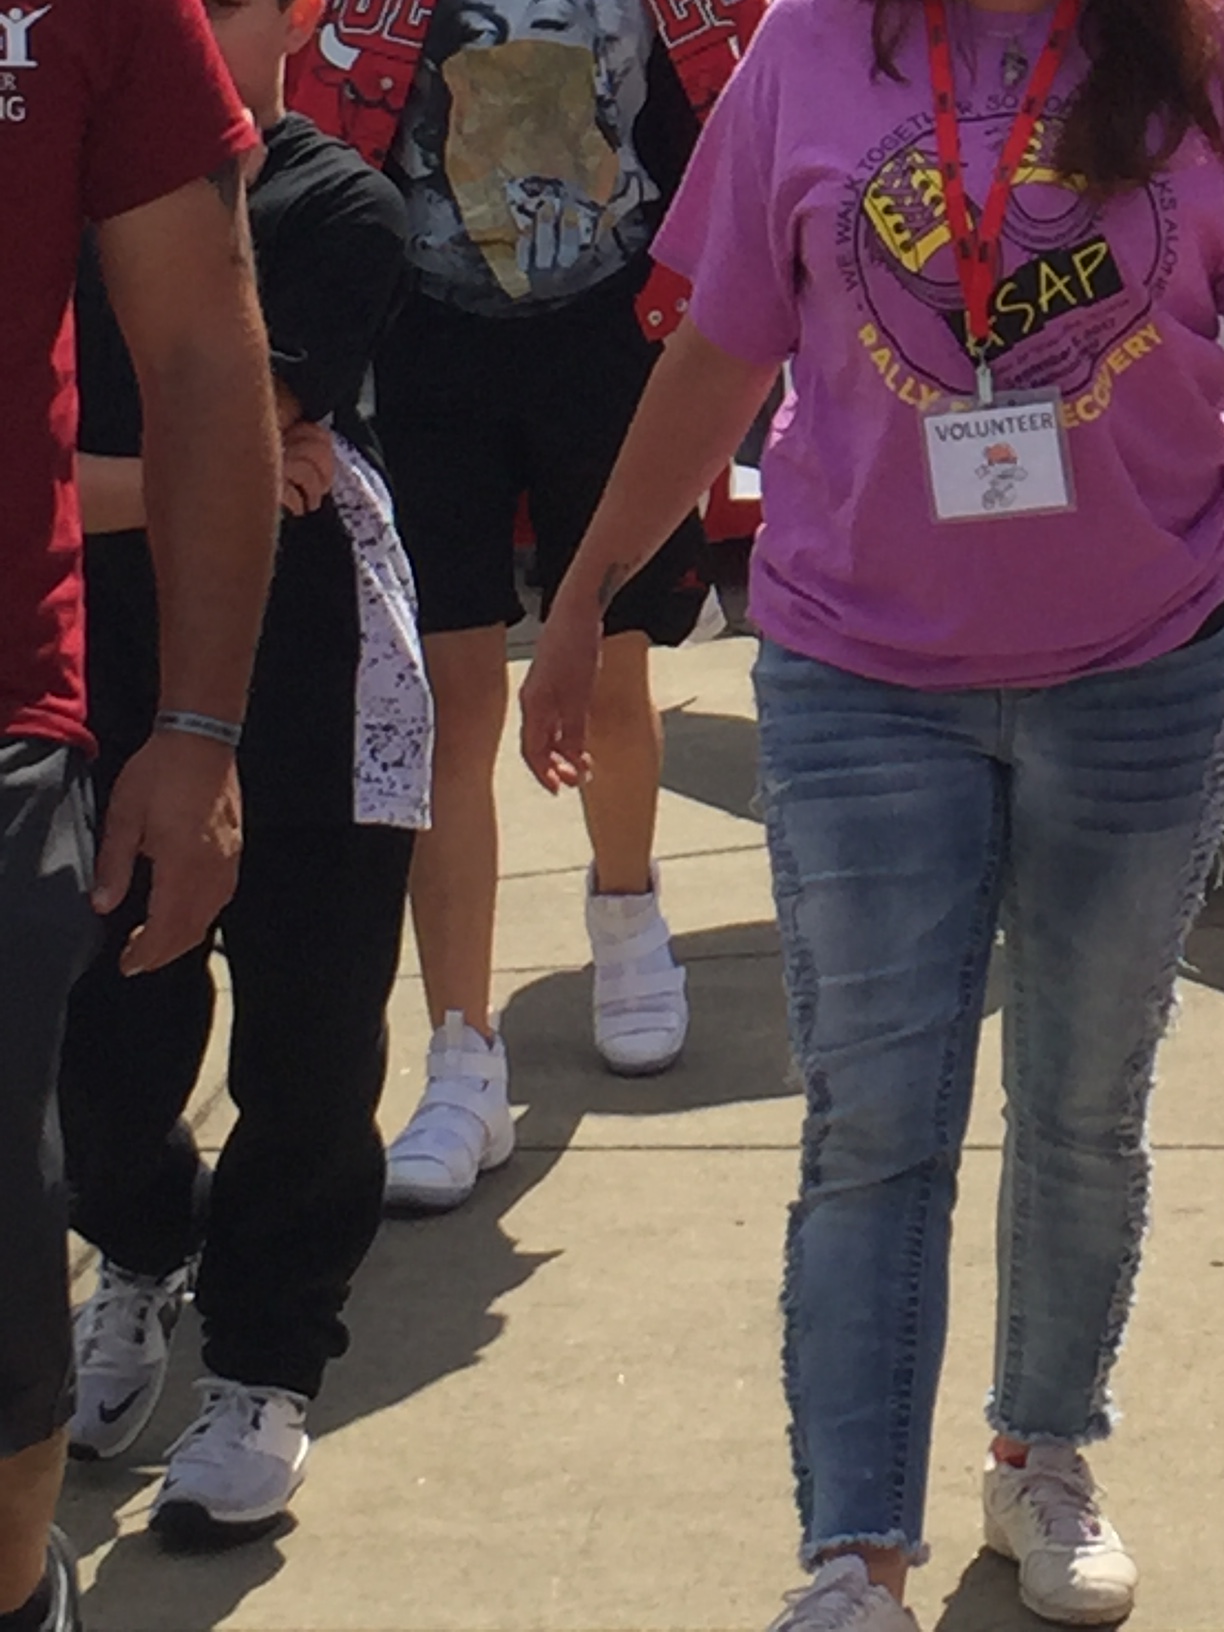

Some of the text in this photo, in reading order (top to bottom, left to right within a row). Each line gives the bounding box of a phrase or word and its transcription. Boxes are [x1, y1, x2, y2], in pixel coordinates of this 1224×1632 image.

[856, 96, 974, 172] TOGETR
[857, 321, 944, 412] RALLY
[1061, 322, 1164, 428] ECOVERY
[934, 411, 1053, 443] VOLUNTEER
